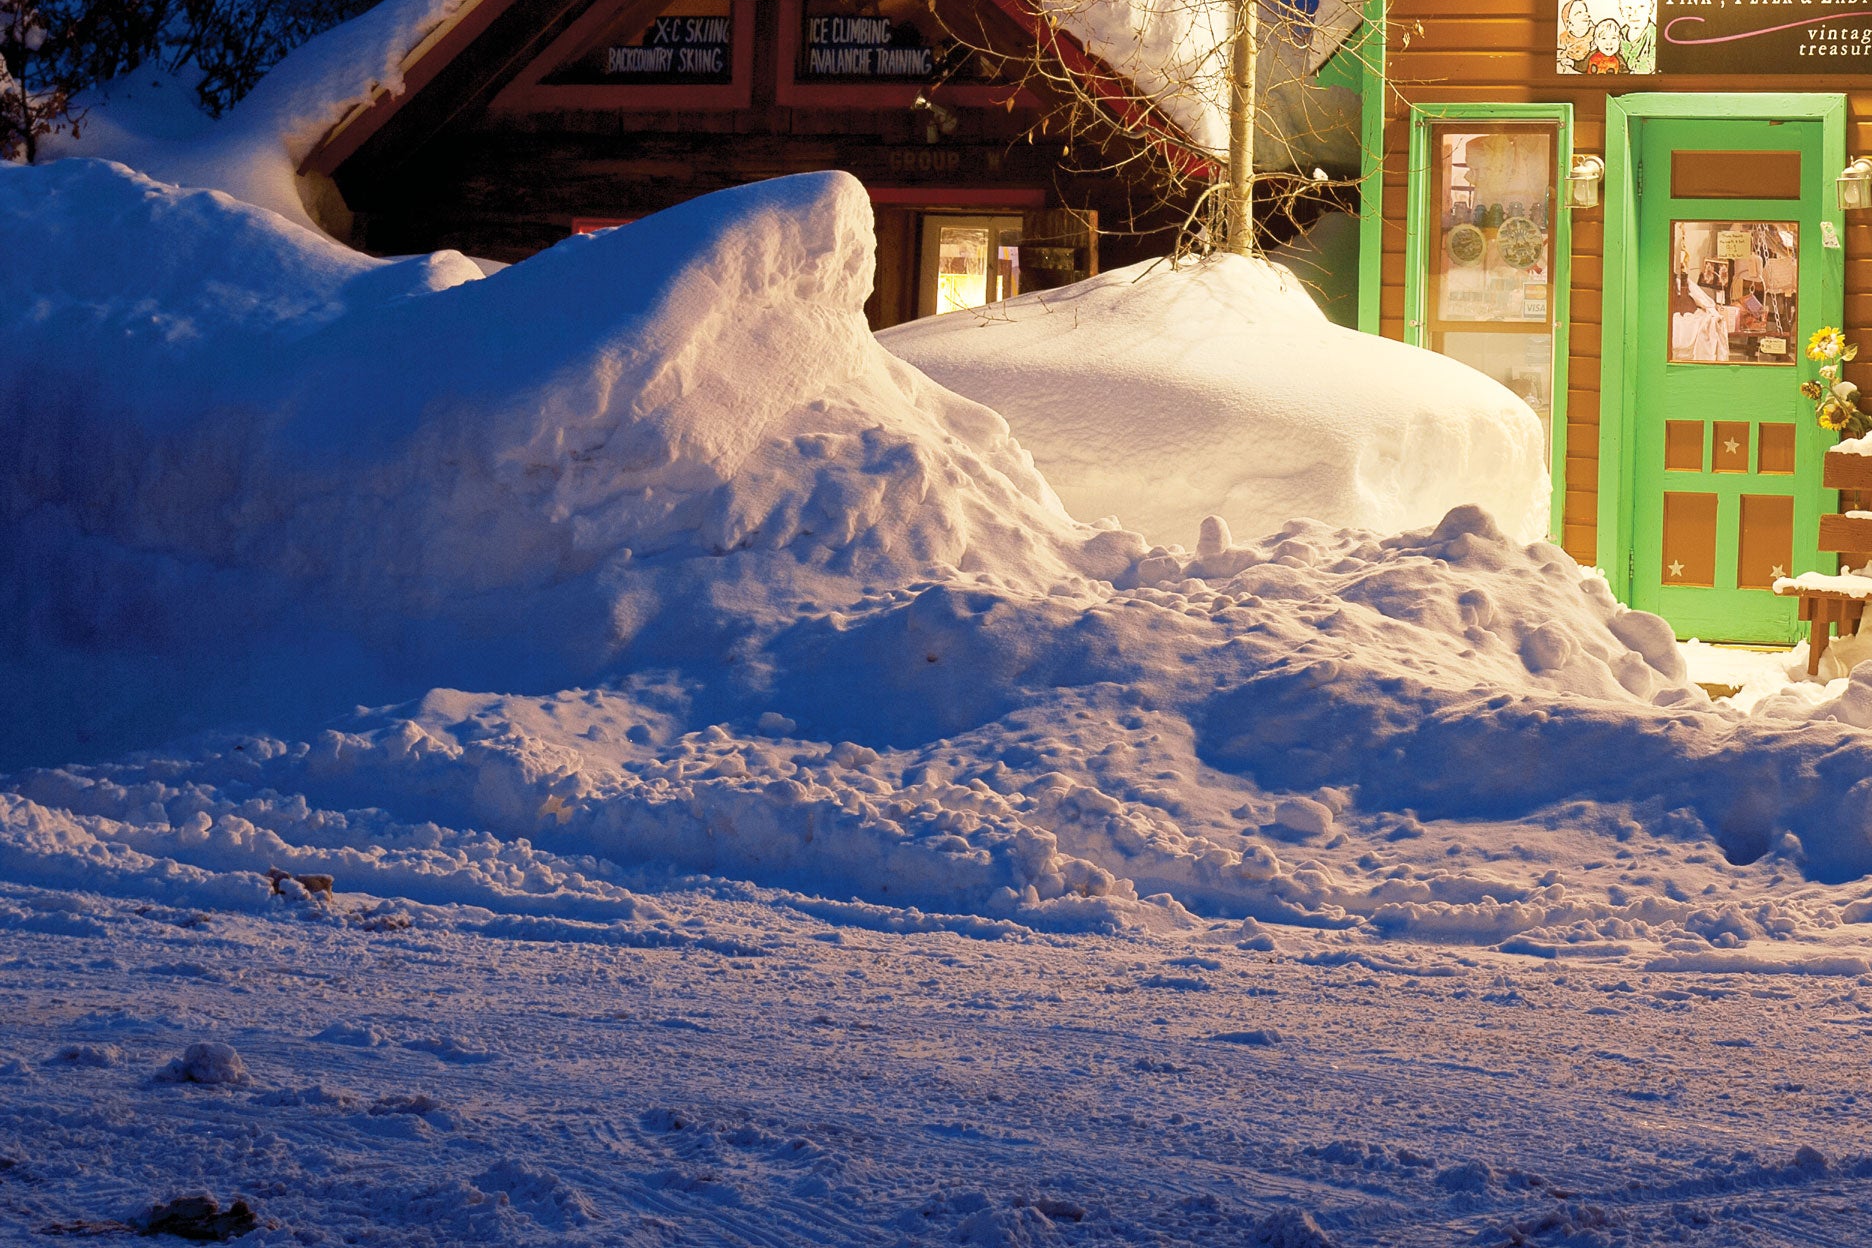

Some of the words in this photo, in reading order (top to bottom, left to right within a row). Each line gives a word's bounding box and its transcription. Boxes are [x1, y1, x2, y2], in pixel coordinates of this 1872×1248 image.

[653, 18, 681, 43] X-C
[685, 18, 730, 43] SKIING
[809, 18, 829, 44] ICE
[832, 17, 892, 44] CLIMBING
[607, 47, 674, 74] BACKCOUNTRY
[678, 47, 723, 74] SKIING
[809, 48, 873, 74] AVALANCHE
[876, 47, 933, 75] TRAINING
[1527, 304, 1546, 312] VISA
